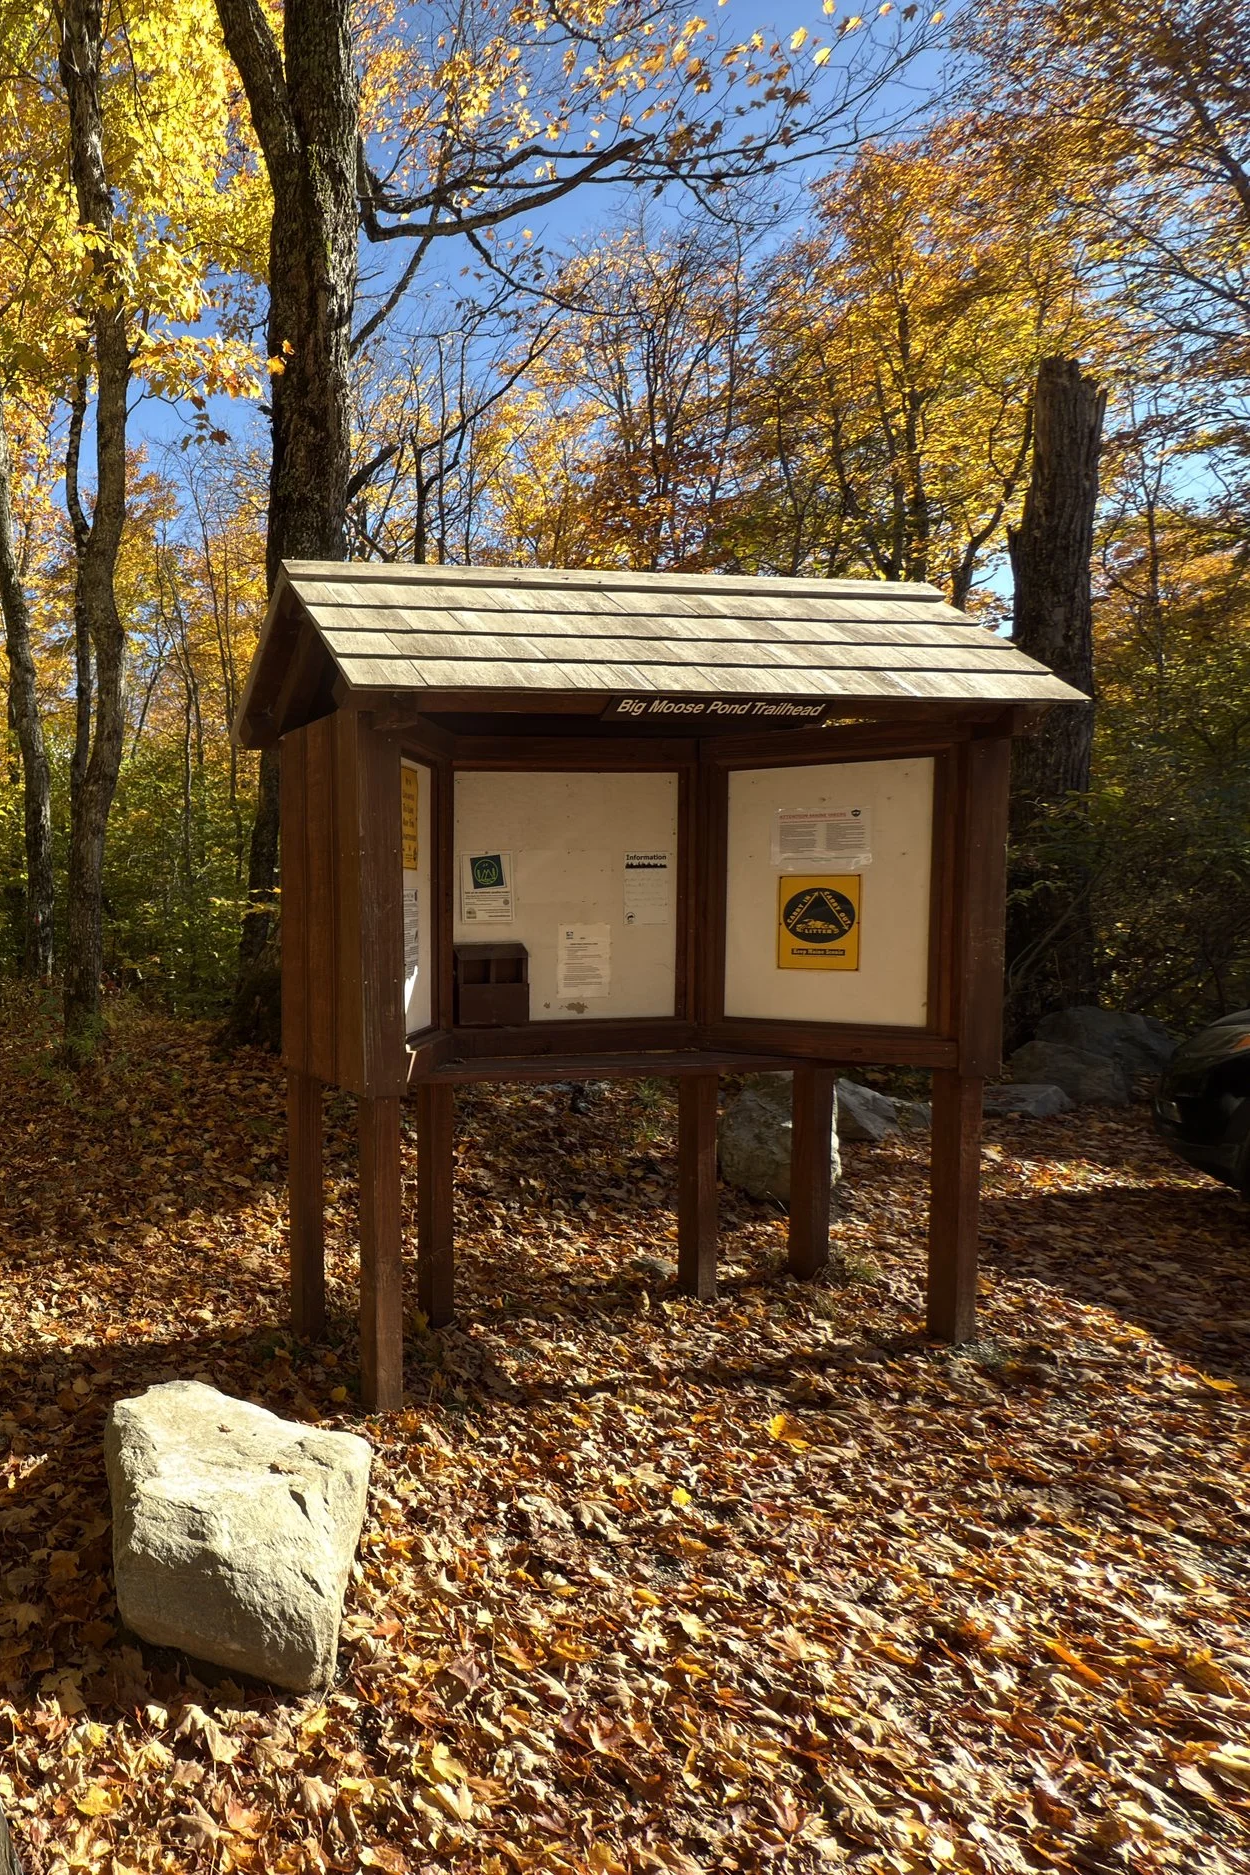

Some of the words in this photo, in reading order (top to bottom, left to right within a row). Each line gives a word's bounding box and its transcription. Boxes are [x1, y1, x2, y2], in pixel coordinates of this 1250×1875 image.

[617, 699, 646, 716] Big
[648, 700, 704, 715] Moose
[706, 701, 751, 715] Pond
[751, 702, 825, 716] Trailhead
[787, 903, 804, 923] CARRY
[803, 895, 811, 903] IN
[823, 891, 841, 911] CARRY
[839, 912, 852, 925] OUT
